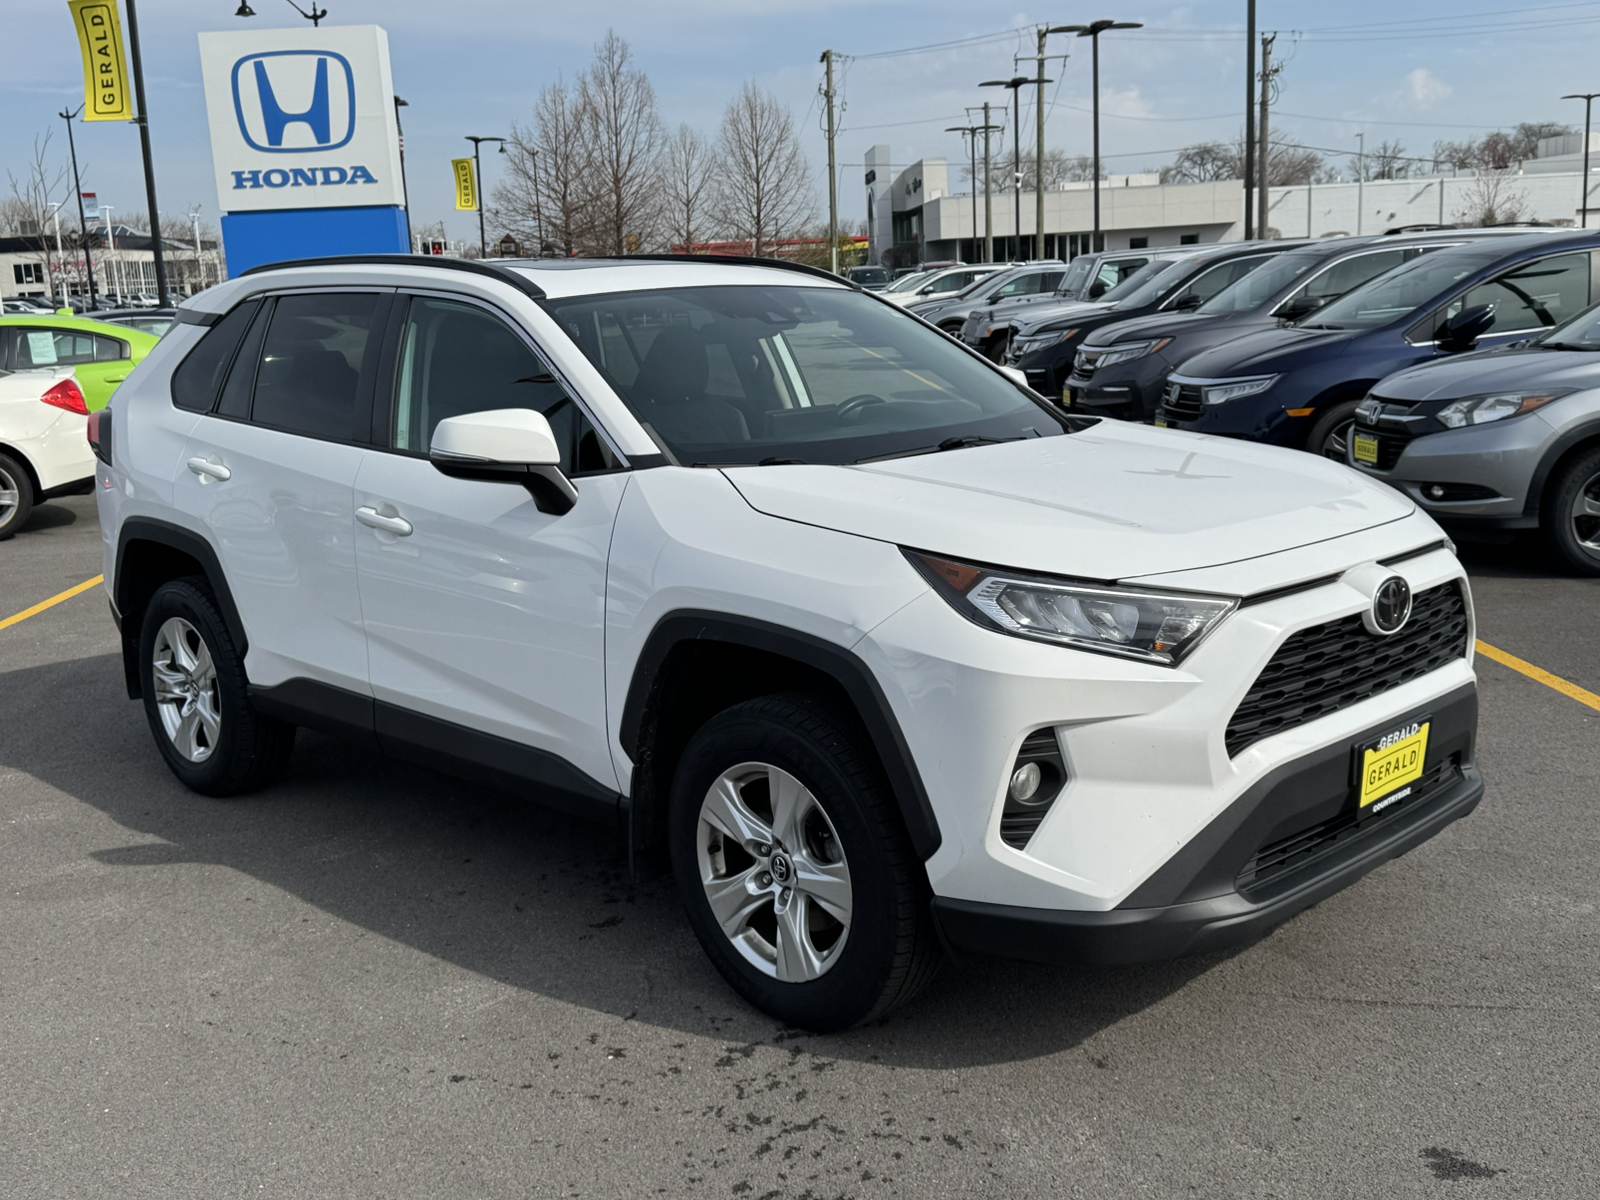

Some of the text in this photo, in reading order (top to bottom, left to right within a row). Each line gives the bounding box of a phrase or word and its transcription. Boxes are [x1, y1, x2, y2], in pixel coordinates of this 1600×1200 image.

[91, 15, 116, 106] GERALD
[231, 165, 379, 190] HONDA
[460, 164, 471, 204] GERALD
[1379, 724, 1418, 749] GERALD
[1369, 750, 1417, 786] GERALD
